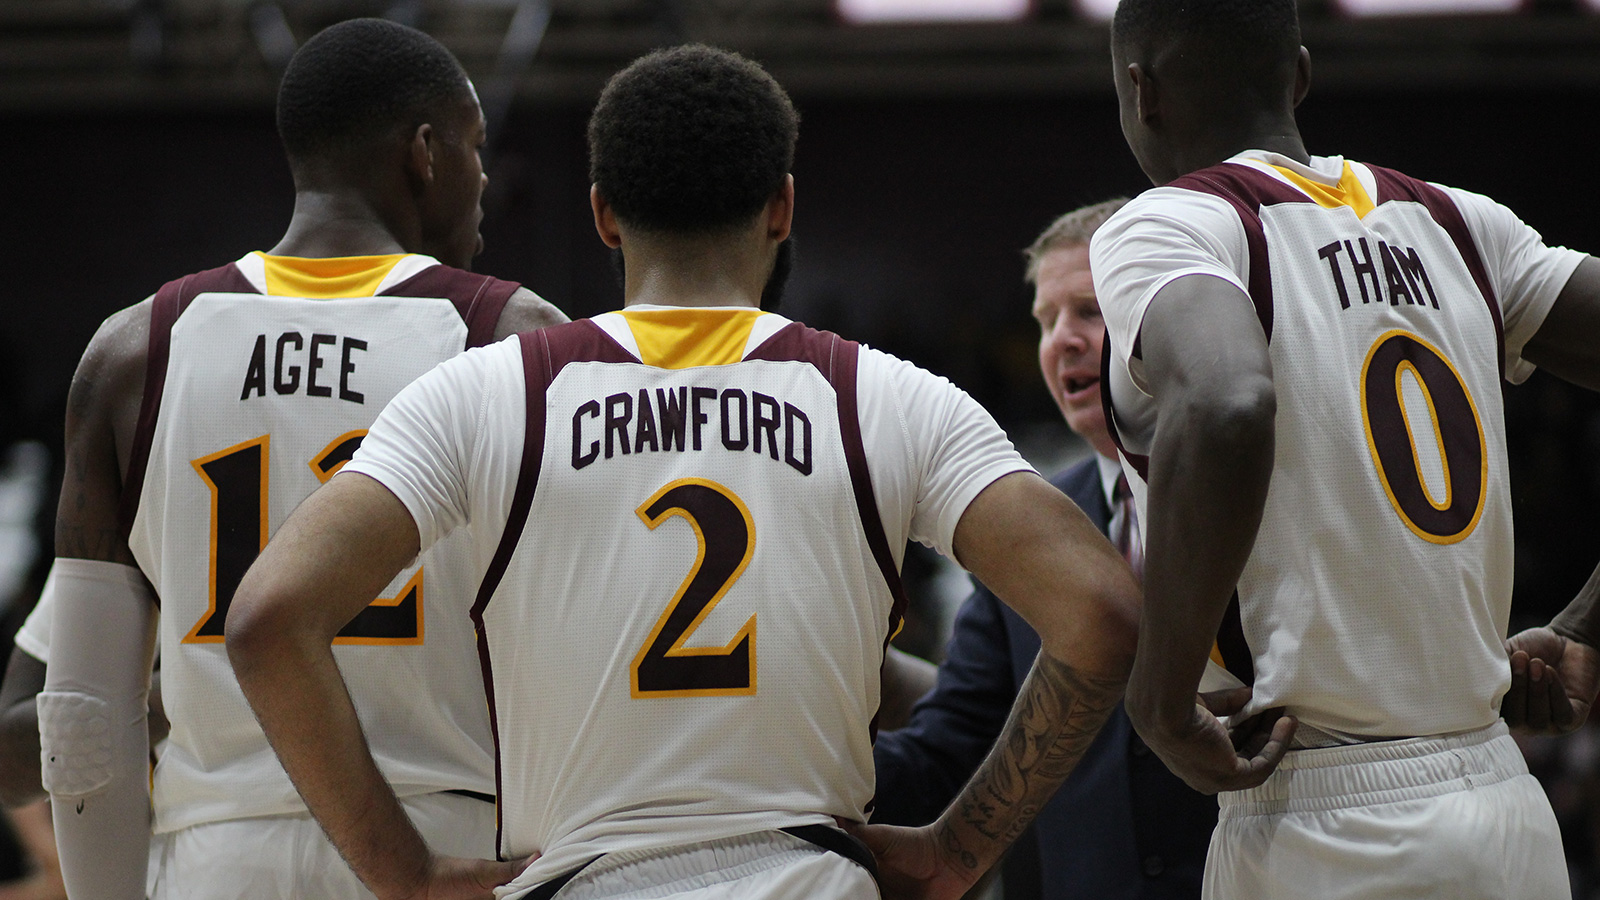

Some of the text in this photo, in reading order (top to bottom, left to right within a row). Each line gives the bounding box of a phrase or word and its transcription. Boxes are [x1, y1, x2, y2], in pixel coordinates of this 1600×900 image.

[1318, 237, 1440, 311] THAM
[240, 331, 368, 404] AGEE
[571, 386, 813, 477] CRAWFORD
[1360, 328, 1488, 545] 0
[629, 476, 757, 699] 2
